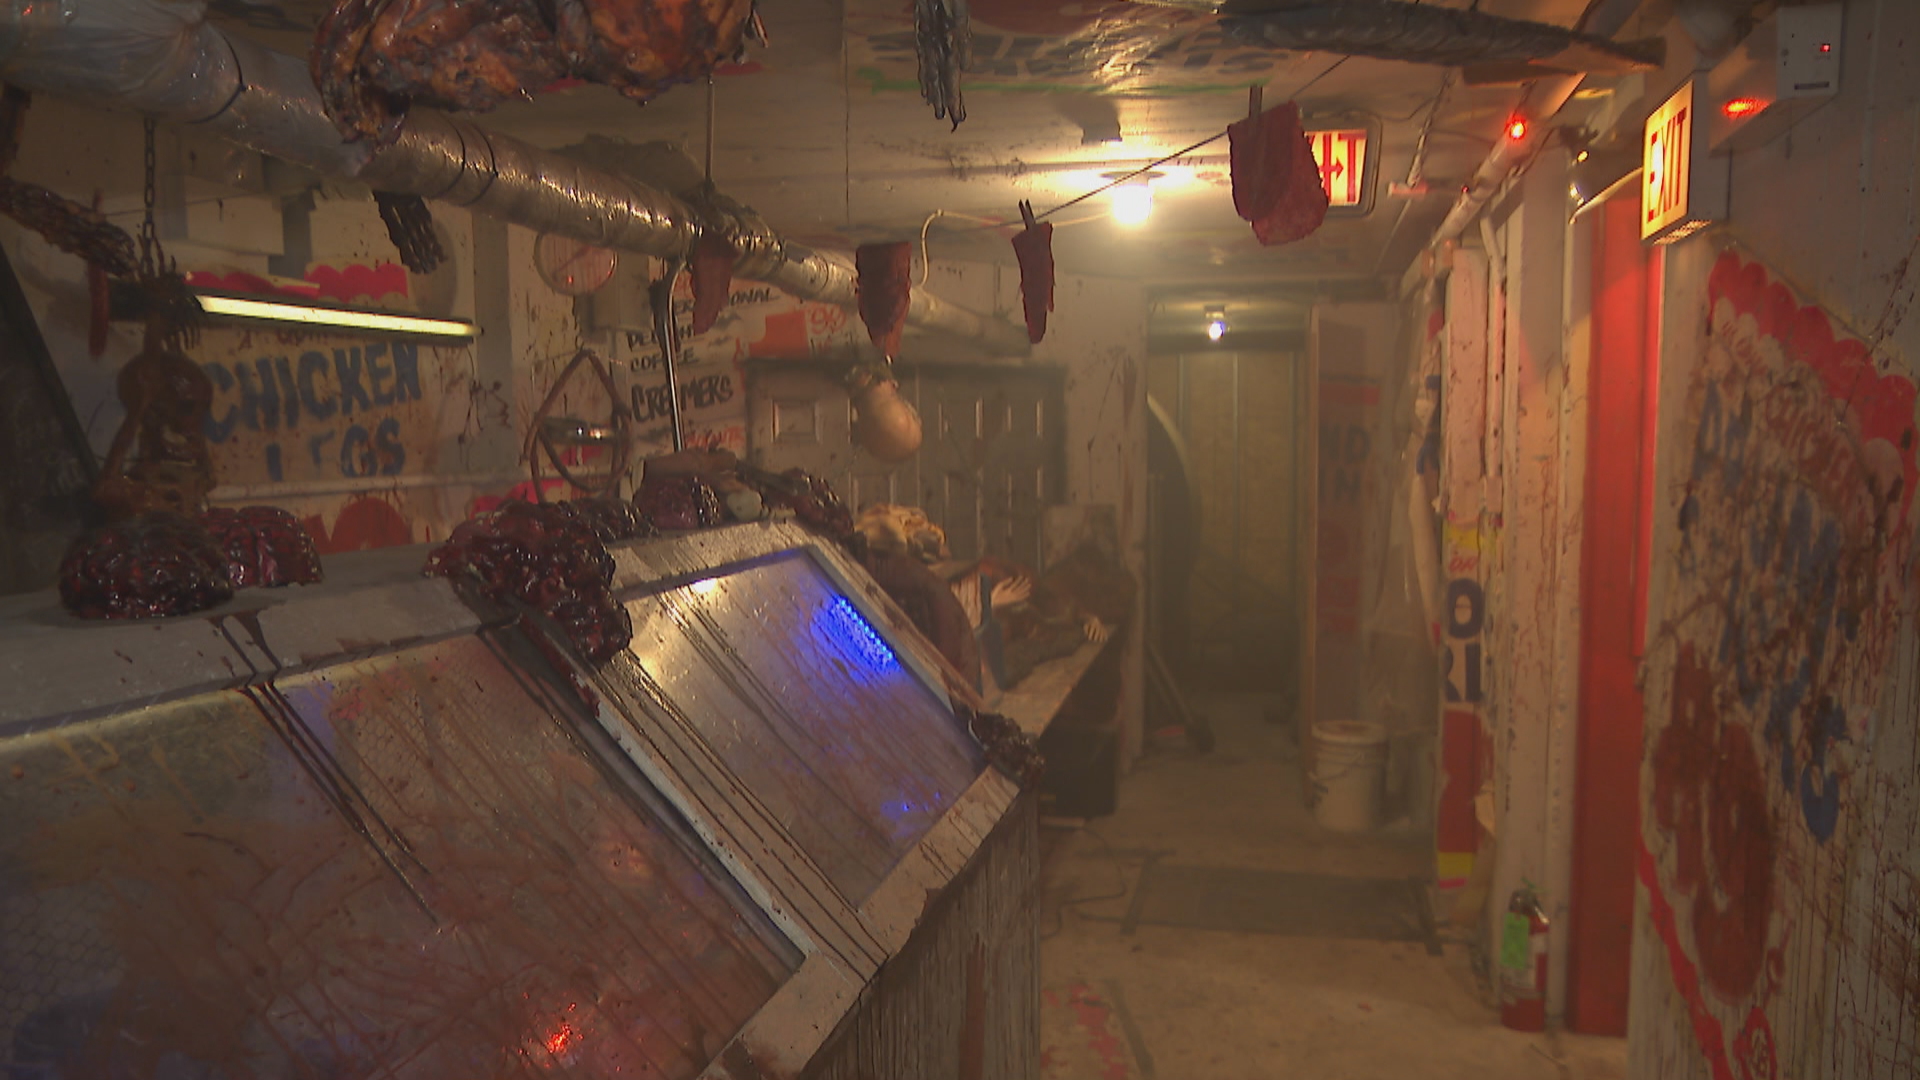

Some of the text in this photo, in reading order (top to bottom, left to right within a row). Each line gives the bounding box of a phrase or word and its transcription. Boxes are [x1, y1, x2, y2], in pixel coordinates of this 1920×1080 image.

[1308, 133, 1367, 203] IT
[1647, 107, 1687, 223] EXIT
[202, 342, 422, 443] CHICKEN
[631, 347, 697, 372] COFEE
[631, 375, 734, 423] CREMERS
